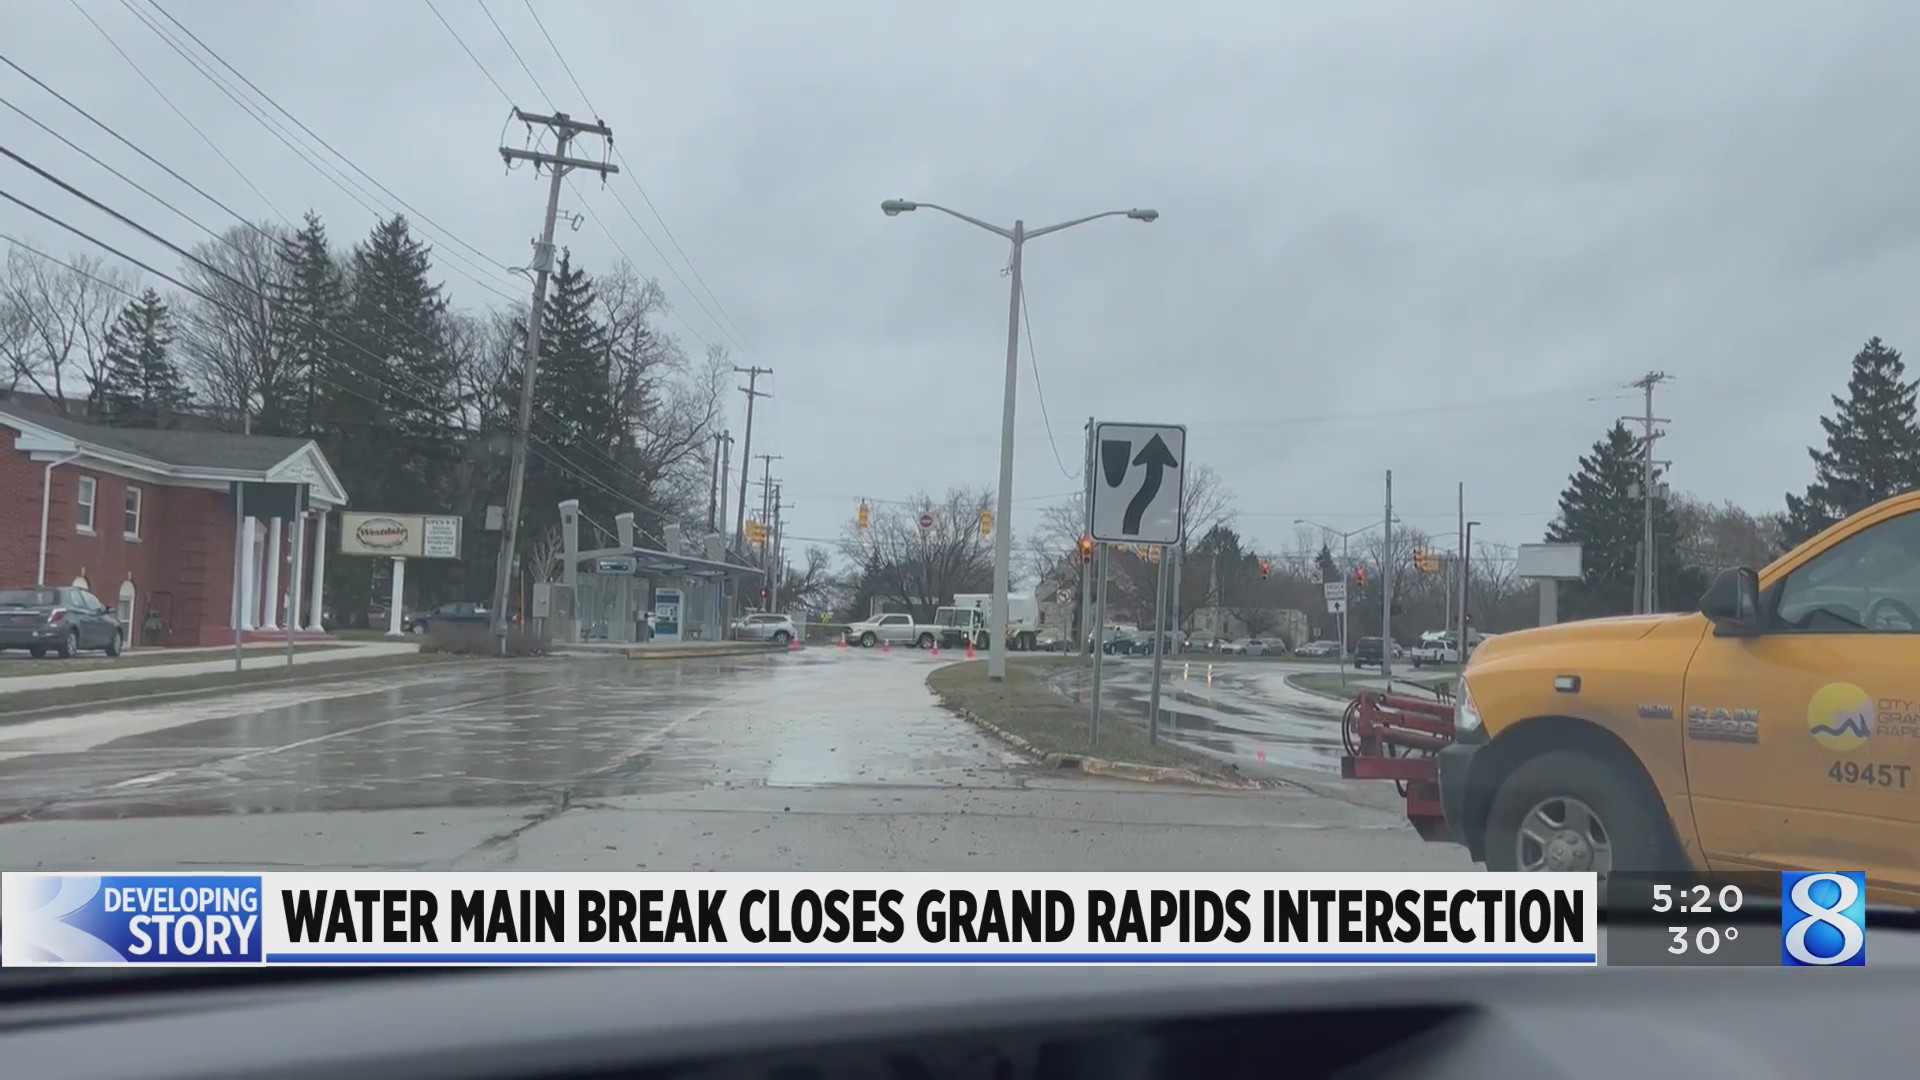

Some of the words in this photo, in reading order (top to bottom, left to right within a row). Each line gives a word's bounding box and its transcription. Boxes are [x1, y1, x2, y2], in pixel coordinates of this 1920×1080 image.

[360, 526, 405, 537] Westdale
[1878, 698, 1914, 711] CITY
[1688, 705, 1759, 720] RAM
[1688, 717, 1759, 734] 2500
[1828, 760, 1912, 788] 4945T
